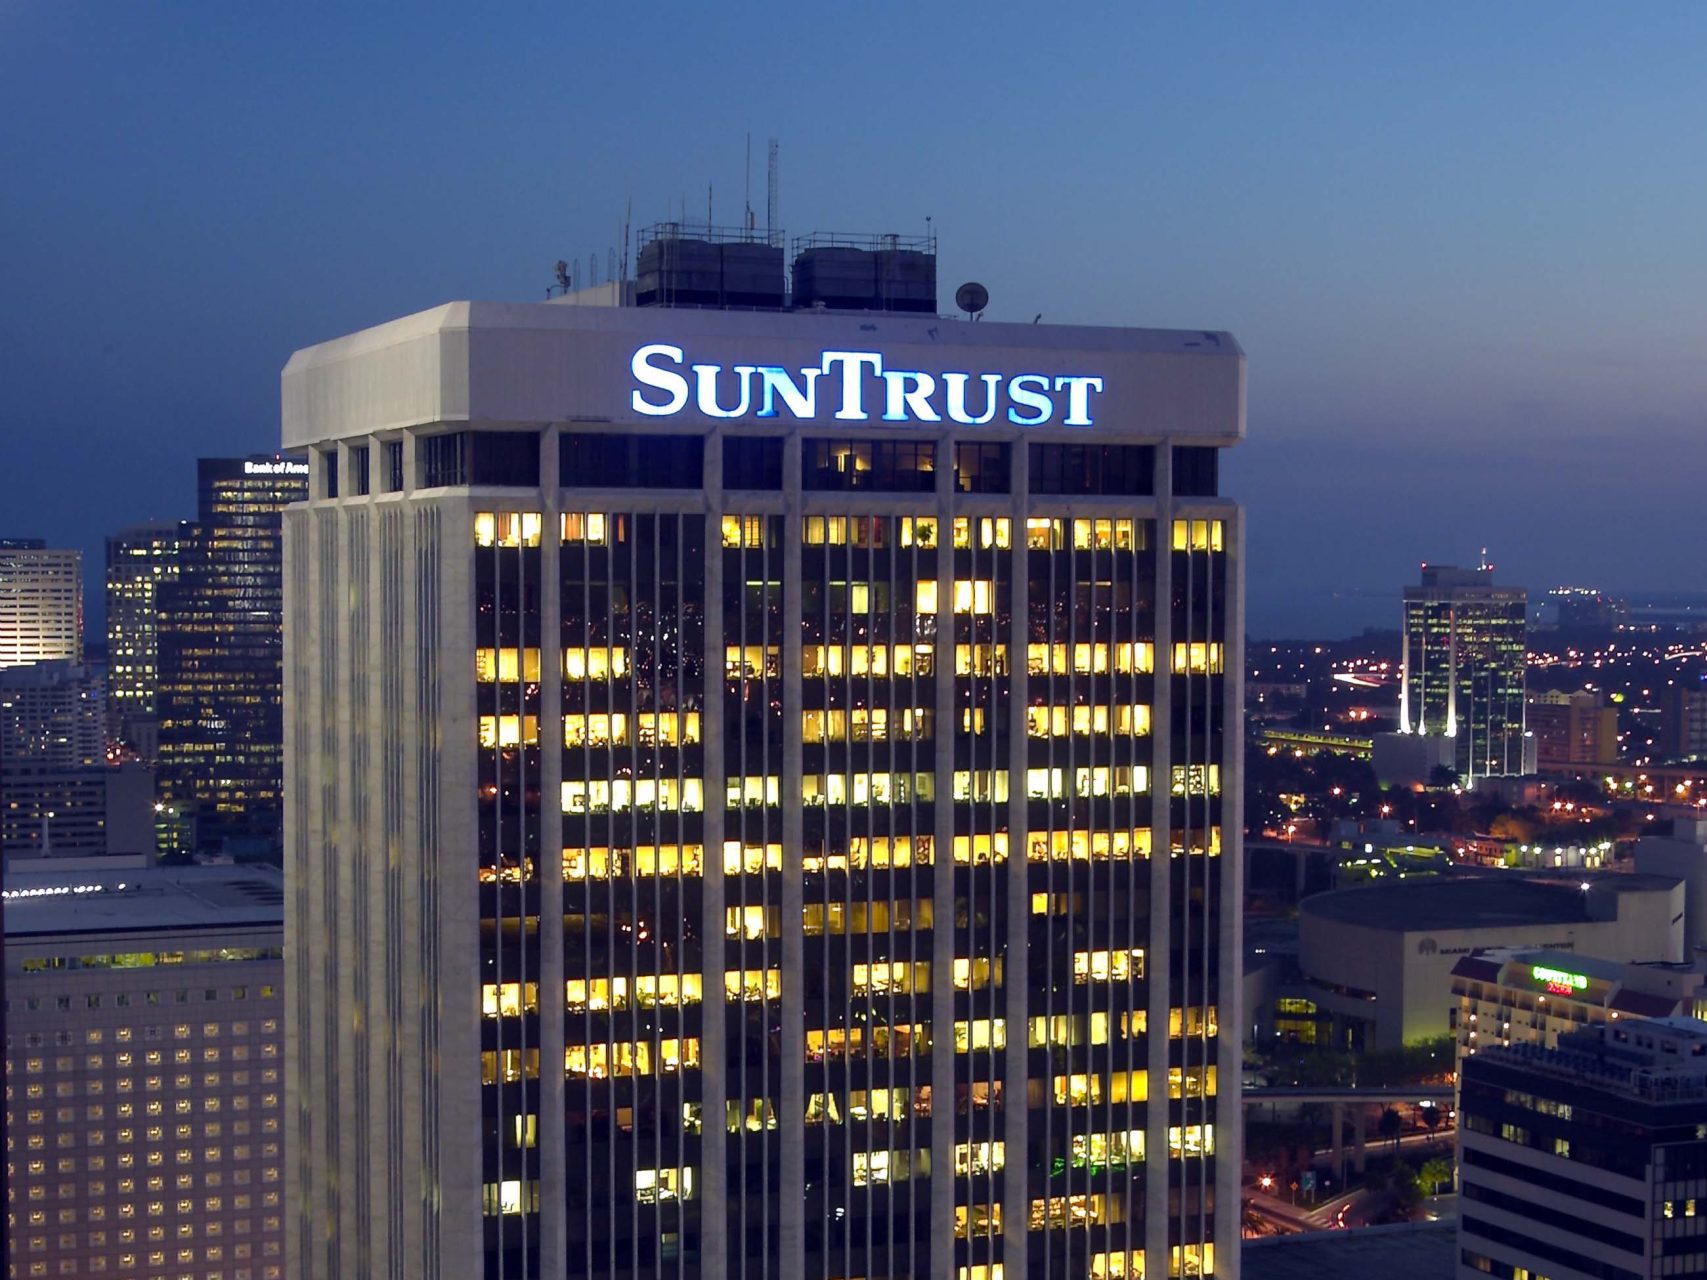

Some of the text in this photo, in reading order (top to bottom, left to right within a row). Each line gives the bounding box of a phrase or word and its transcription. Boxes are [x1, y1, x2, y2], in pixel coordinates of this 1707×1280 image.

[630, 343, 1104, 426] SUNTRUST
[244, 461, 272, 474] Bank
[273, 461, 286, 474] of
[1537, 941, 1575, 951] ENTER
